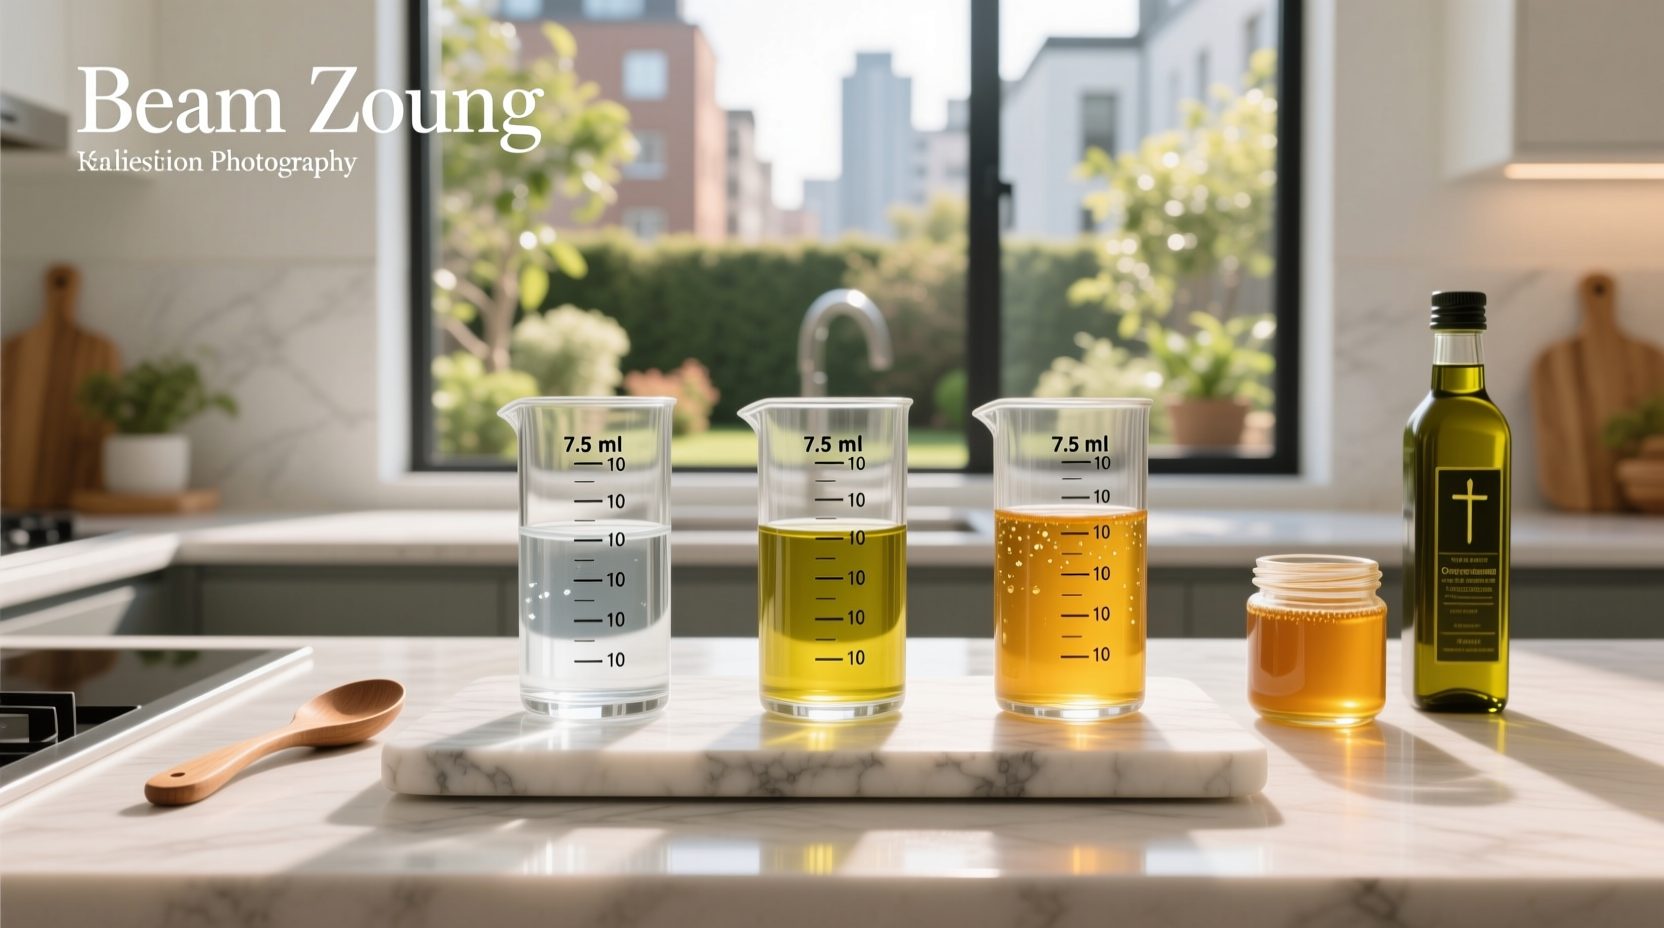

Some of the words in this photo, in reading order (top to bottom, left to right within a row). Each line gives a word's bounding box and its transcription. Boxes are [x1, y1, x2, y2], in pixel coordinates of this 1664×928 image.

[563, 436, 592, 453] 7.5
[598, 435, 623, 453] ml
[803, 436, 832, 453] 7.5
[838, 435, 863, 453] ml
[1051, 436, 1079, 453] 7.5
[1085, 435, 1109, 453] ml
[606, 457, 626, 471] 10
[847, 456, 866, 471] 10
[1093, 456, 1111, 470] 10
[606, 494, 626, 508] 10
[847, 493, 866, 507] 10
[1093, 489, 1111, 504] 10
[606, 532, 626, 547] 10
[847, 530, 866, 545] 10
[1093, 525, 1111, 539] 10
[606, 572, 626, 587] 10
[847, 570, 866, 585] 10
[1093, 566, 1111, 581] 10
[606, 612, 626, 627] 10
[847, 610, 866, 625] 10
[1093, 607, 1111, 621] 10
[606, 652, 626, 667] 10
[847, 650, 866, 665] 10
[1093, 647, 1111, 662] 10
